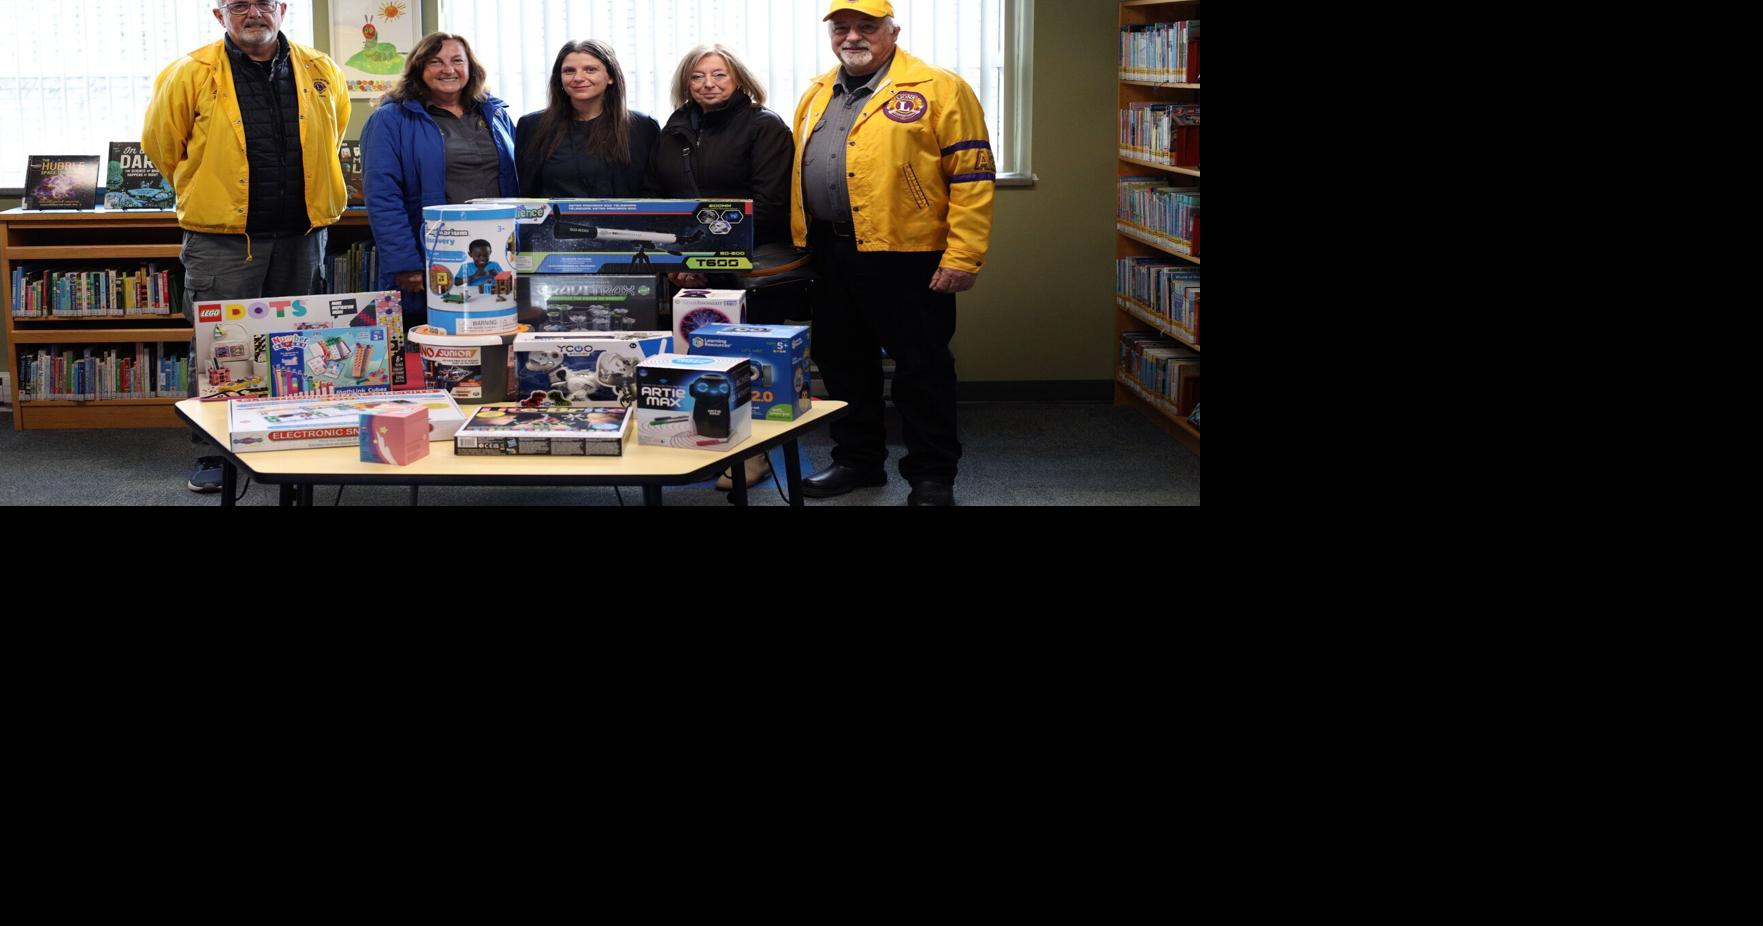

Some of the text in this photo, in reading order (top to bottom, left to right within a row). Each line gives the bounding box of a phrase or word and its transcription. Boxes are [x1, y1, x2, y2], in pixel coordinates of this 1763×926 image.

[899, 101, 910, 112] L
[123, 146, 138, 154] In
[42, 161, 86, 171] HUBBLE
[120, 154, 154, 169] DAR
[695, 259, 739, 267] T600
[200, 300, 308, 321] LEGO DOTS
[776, 341, 788, 350] 5+
[439, 349, 473, 358] JUNIOR
[641, 386, 686, 399] ARTIE
[751, 390, 774, 403] 2.0
[646, 396, 681, 408] MAX
[272, 427, 360, 440] ELECTRONIC SN
